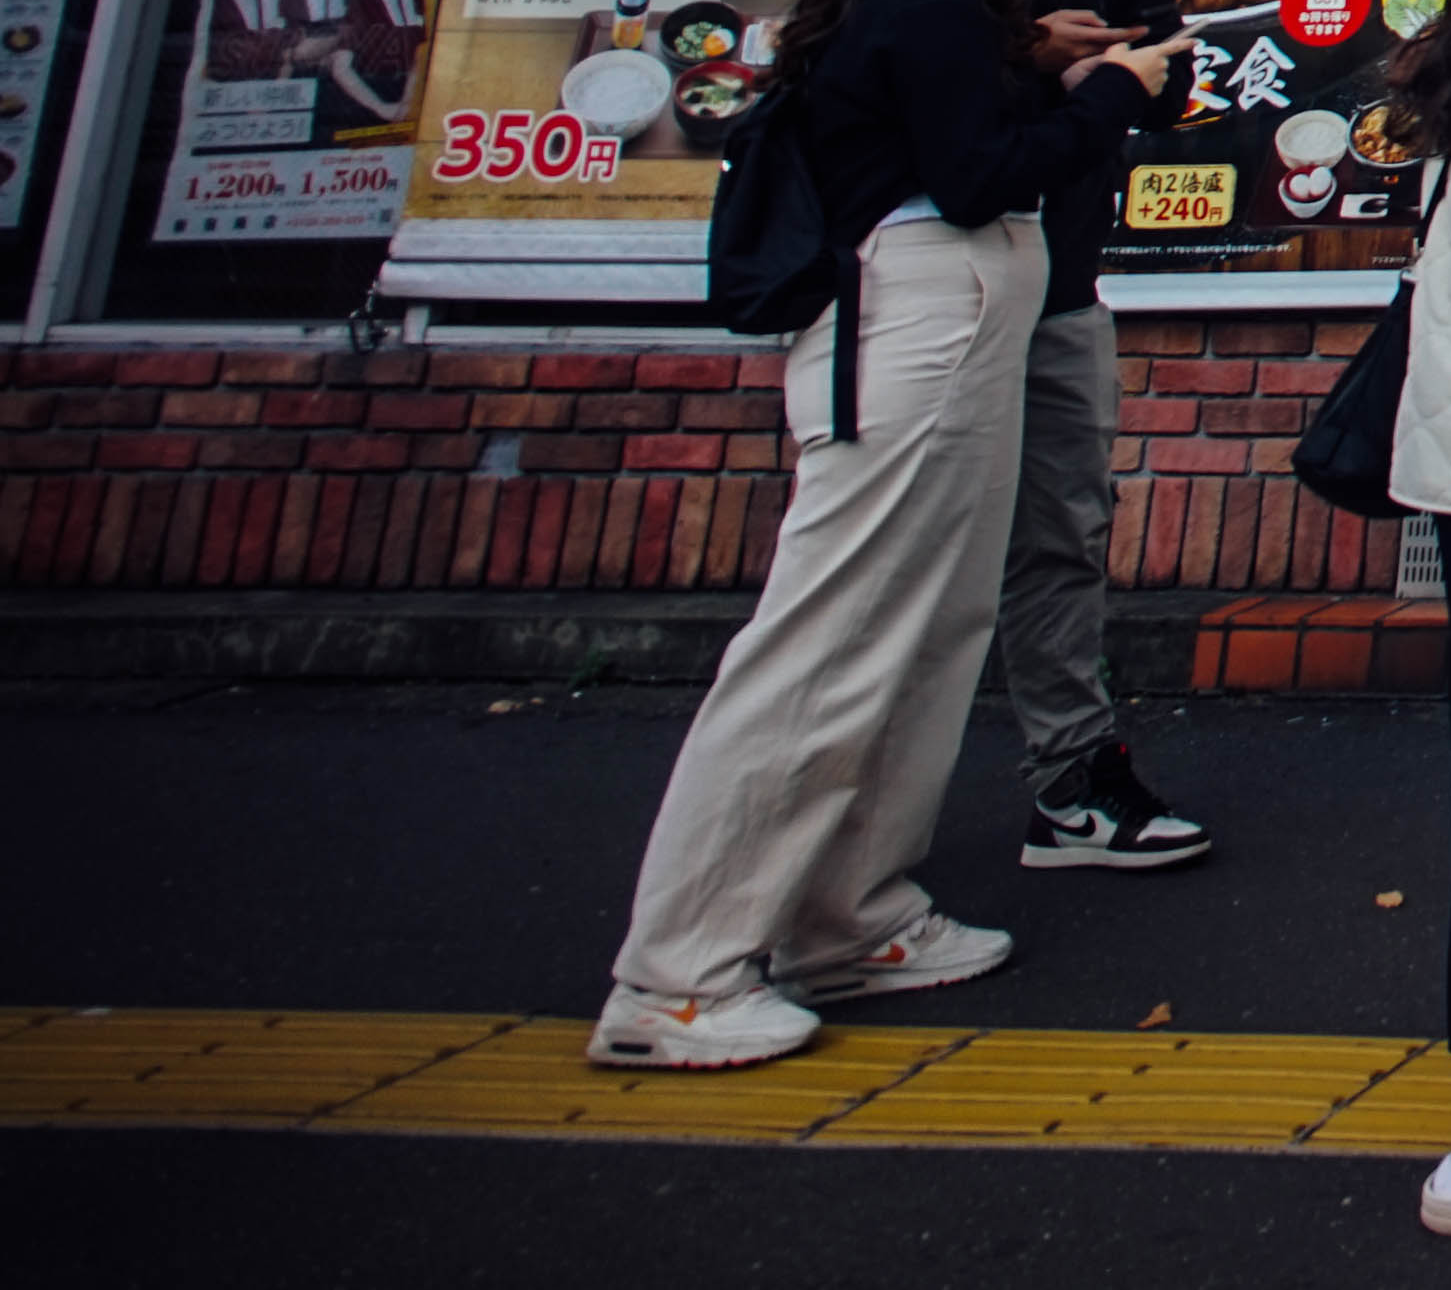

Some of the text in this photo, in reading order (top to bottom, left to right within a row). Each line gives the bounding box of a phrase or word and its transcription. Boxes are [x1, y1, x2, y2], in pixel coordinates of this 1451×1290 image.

[433, 110, 620, 183] 350円
[184, 167, 399, 201] 1,200円 1,500円
[1138, 196, 1223, 222] +240円
